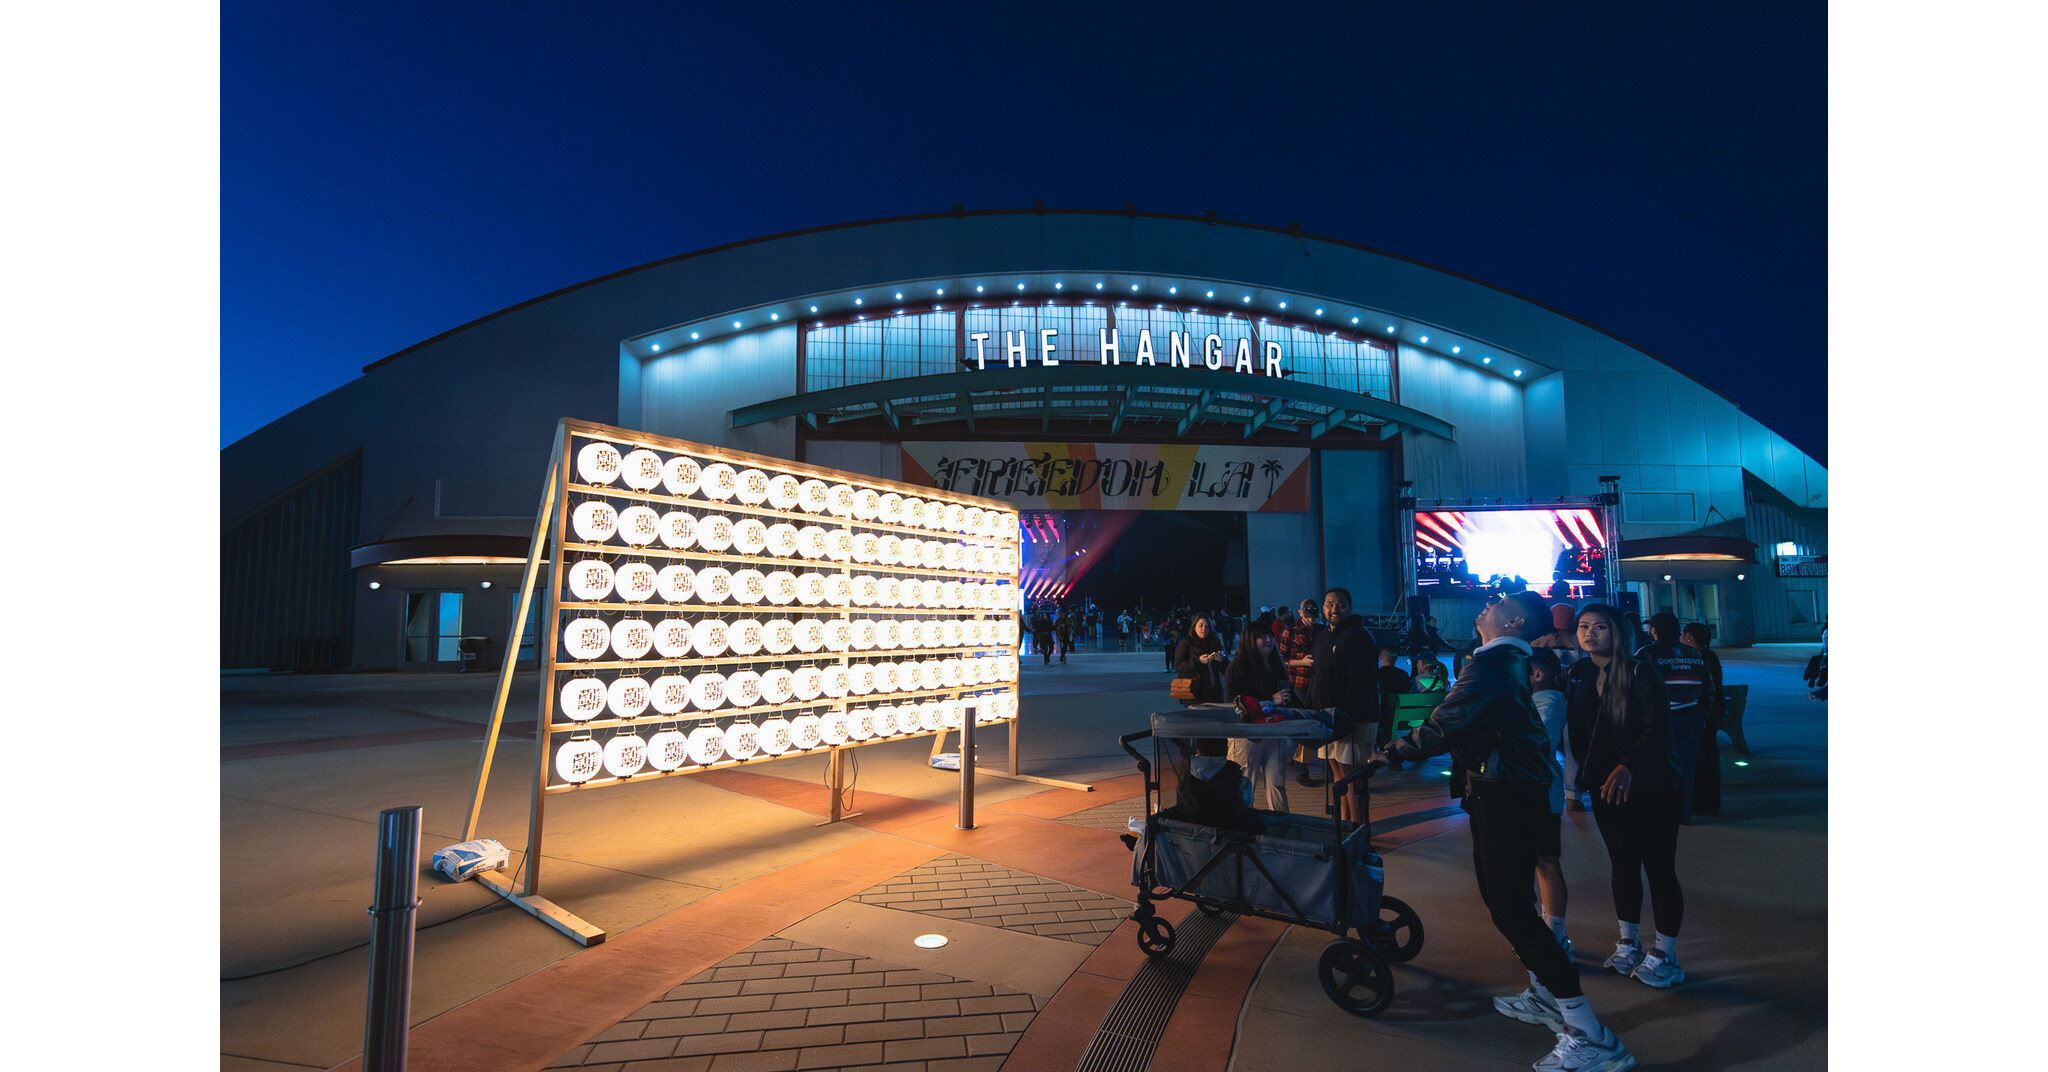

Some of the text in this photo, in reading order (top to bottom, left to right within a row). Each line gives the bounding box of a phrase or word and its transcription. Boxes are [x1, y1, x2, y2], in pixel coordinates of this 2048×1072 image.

[970, 327, 1283, 379] THE HANGAR
[934, 452, 1255, 498] FREEDOM LA
[1781, 562, 1828, 575] BOX OFFICE
